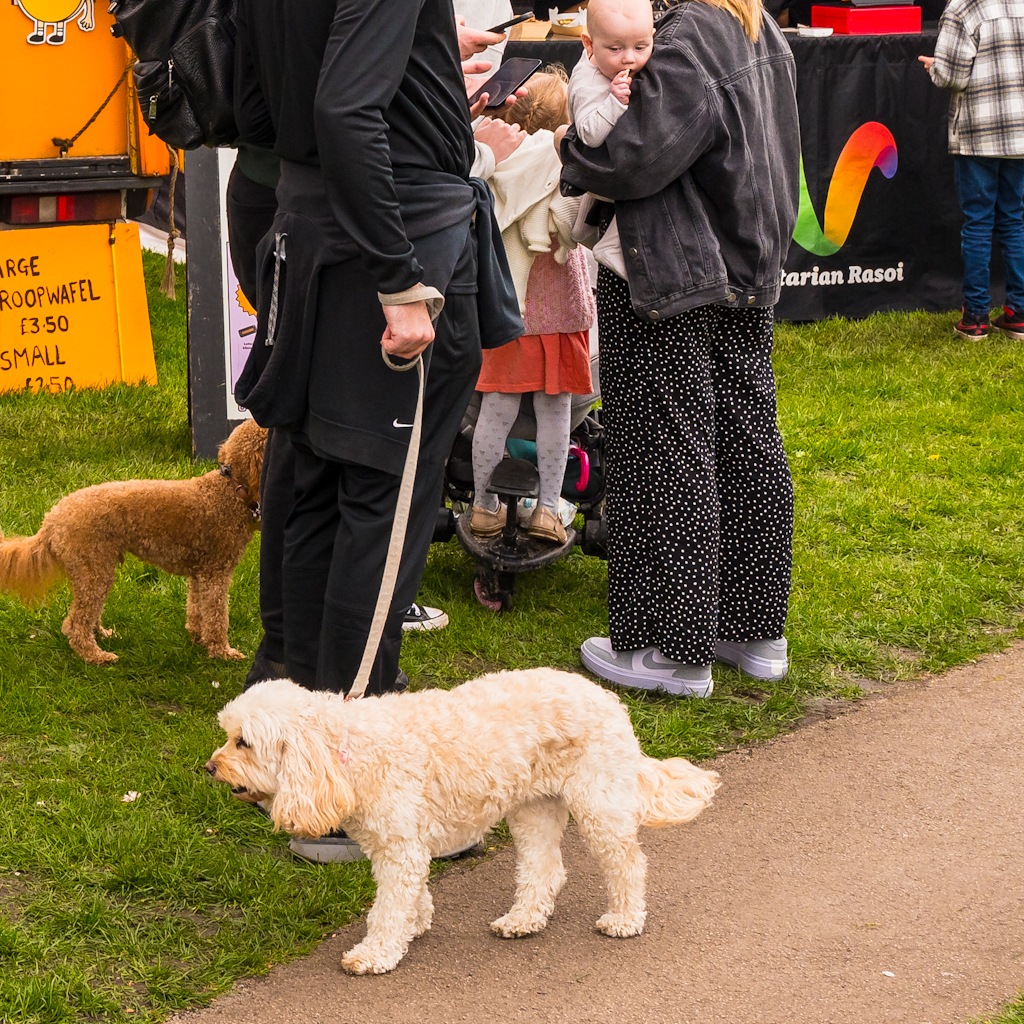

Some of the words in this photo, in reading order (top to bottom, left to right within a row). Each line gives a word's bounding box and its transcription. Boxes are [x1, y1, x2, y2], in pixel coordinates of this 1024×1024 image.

[780, 265, 845, 287] tarian
[847, 261, 904, 284] Rasoi
[0, 344, 66, 371] SMALL
